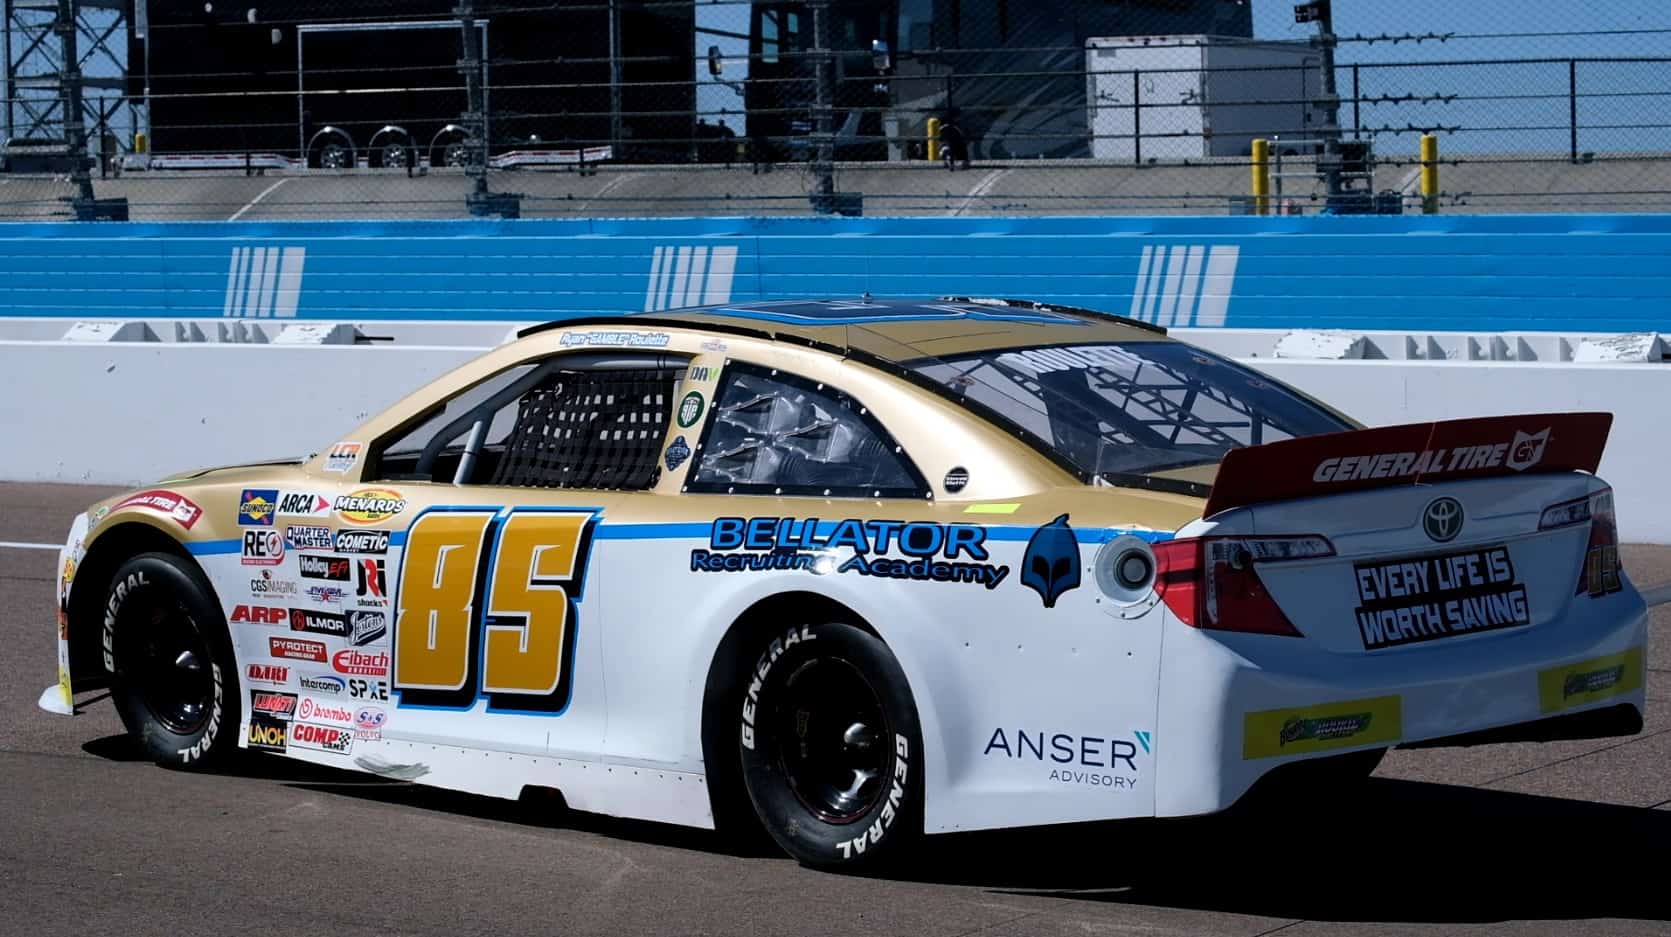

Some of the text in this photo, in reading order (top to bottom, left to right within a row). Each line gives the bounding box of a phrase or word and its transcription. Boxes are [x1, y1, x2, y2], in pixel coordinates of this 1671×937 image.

[1313, 443, 1510, 483] GENERAL TIRE
[241, 503, 275, 514] SUNOCO
[279, 493, 315, 514] ARCA
[334, 496, 407, 514] MENARDS
[287, 527, 329, 540] QUARTER
[294, 537, 331, 547] MASTER
[336, 531, 389, 551] COMETIC
[710, 517, 989, 560] BELLATOR
[300, 556, 329, 578] Holley
[690, 549, 1009, 589] Recruitin Academy
[1357, 549, 1511, 601] EVERY LIFE IS
[230, 605, 287, 624] ARP
[392, 506, 602, 714] 85
[1359, 590, 1528, 645] WORTH SAVING
[103, 570, 151, 673] GENERAL
[306, 616, 345, 631] ILMOR
[272, 640, 324, 654] PYROTECT
[332, 650, 389, 675] Eibach
[299, 676, 341, 694] Intercomp
[741, 624, 817, 750] GENERAL
[178, 661, 223, 764] GENERAL
[314, 704, 352, 722] brembo
[249, 723, 286, 746] UNOH
[293, 725, 340, 744] COMP
[984, 727, 1137, 771] ANSER
[1049, 769, 1138, 790] ADVISORY
[836, 732, 909, 860] GENERAL
